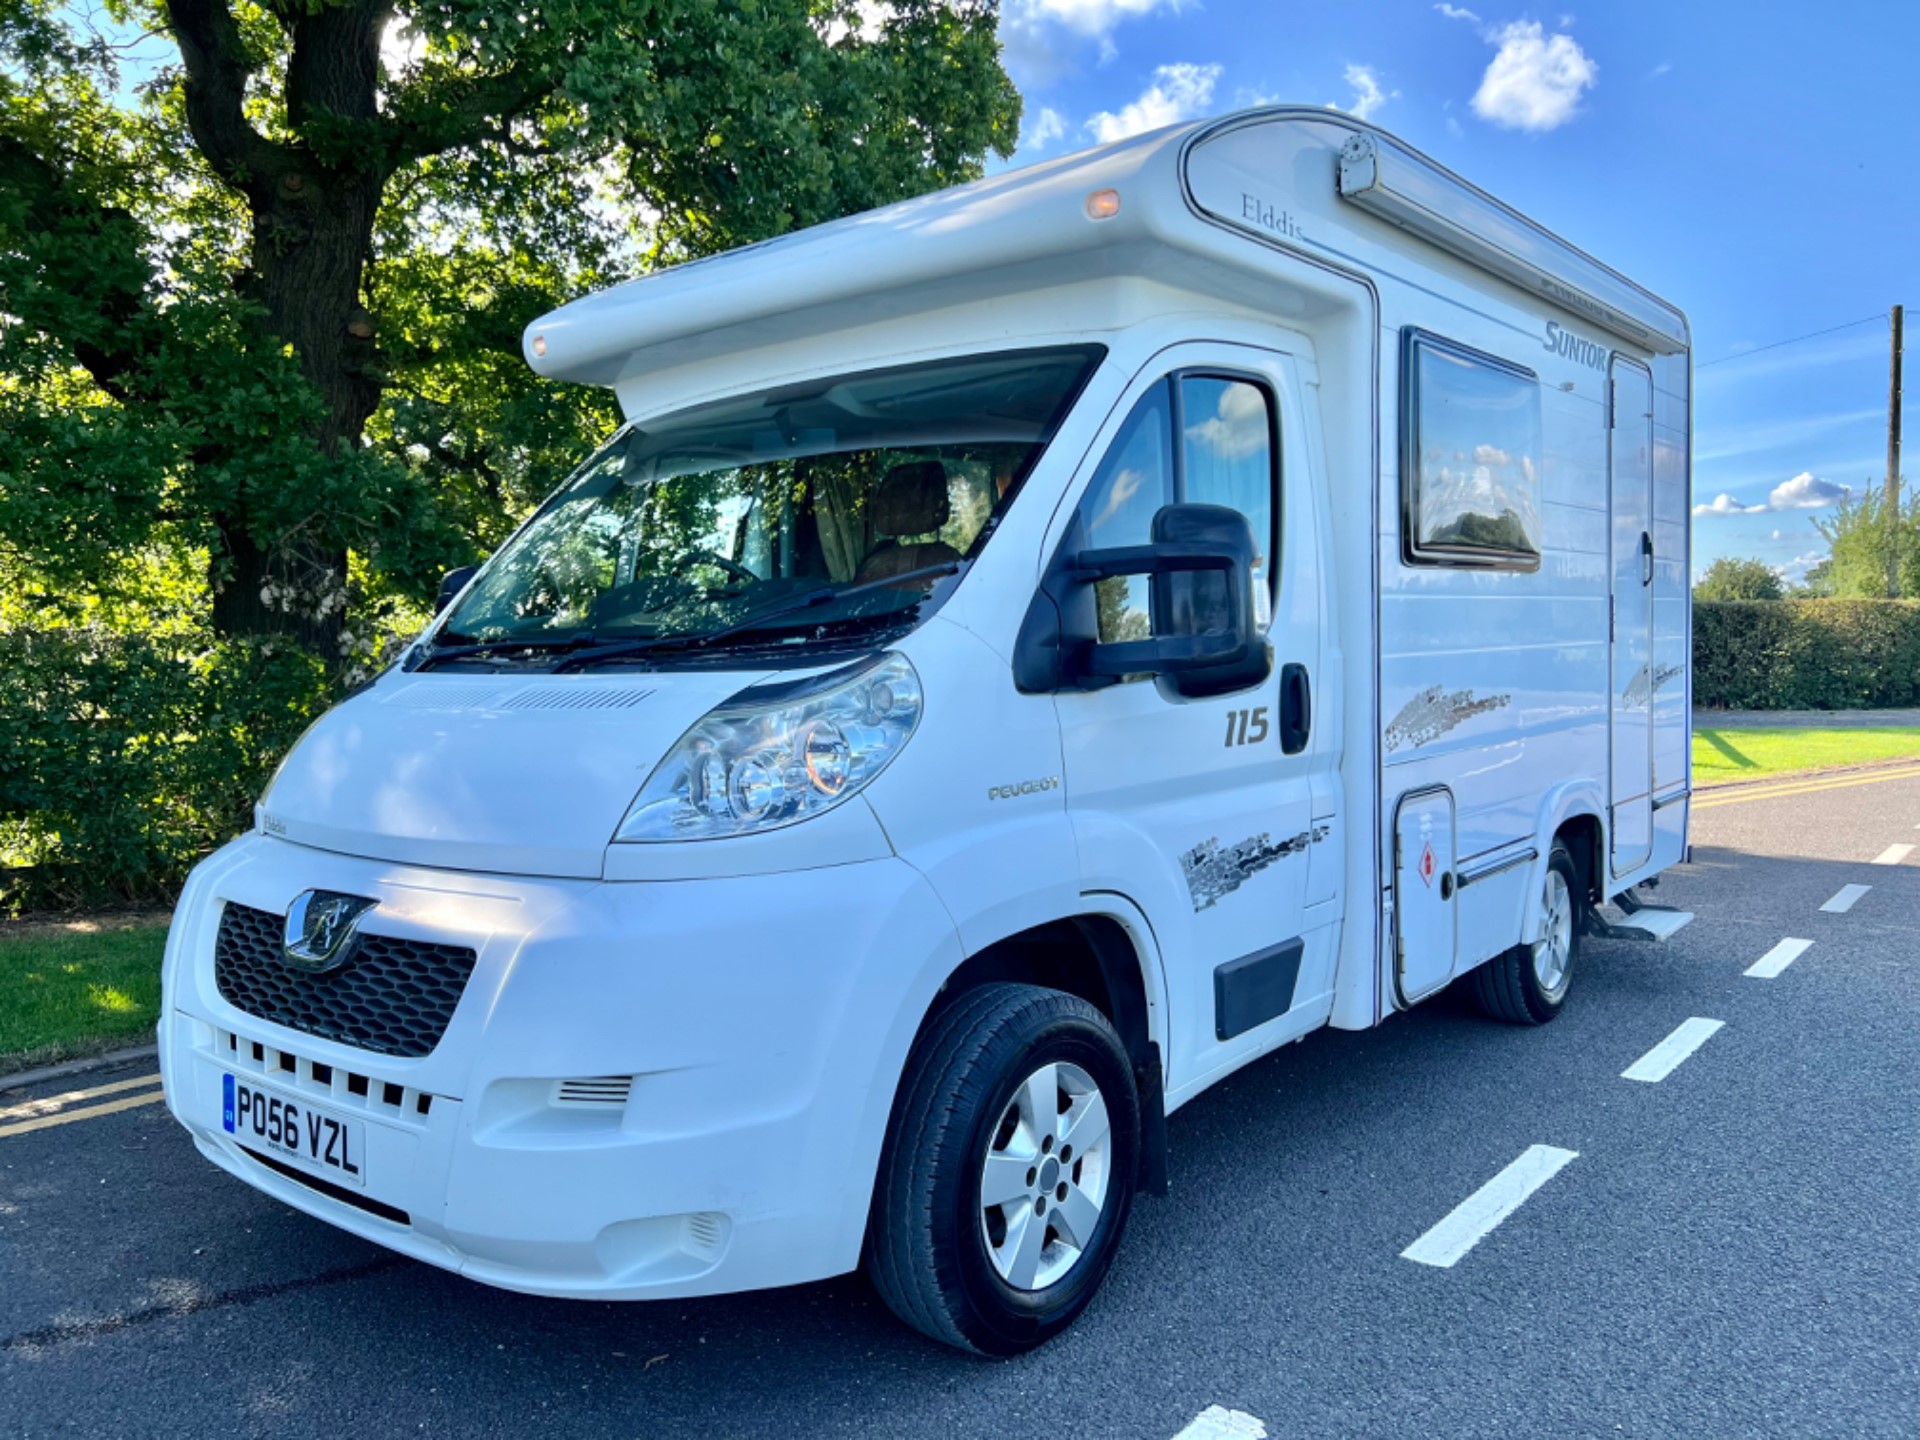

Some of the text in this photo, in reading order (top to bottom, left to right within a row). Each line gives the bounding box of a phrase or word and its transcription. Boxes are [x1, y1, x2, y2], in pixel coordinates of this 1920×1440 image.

[1241, 192, 1304, 240] Elddis
[1224, 706, 1269, 747] 115
[988, 775, 1059, 801] PEUGEOT
[238, 1085, 299, 1149] PO56
[307, 1110, 359, 1176] VZL
